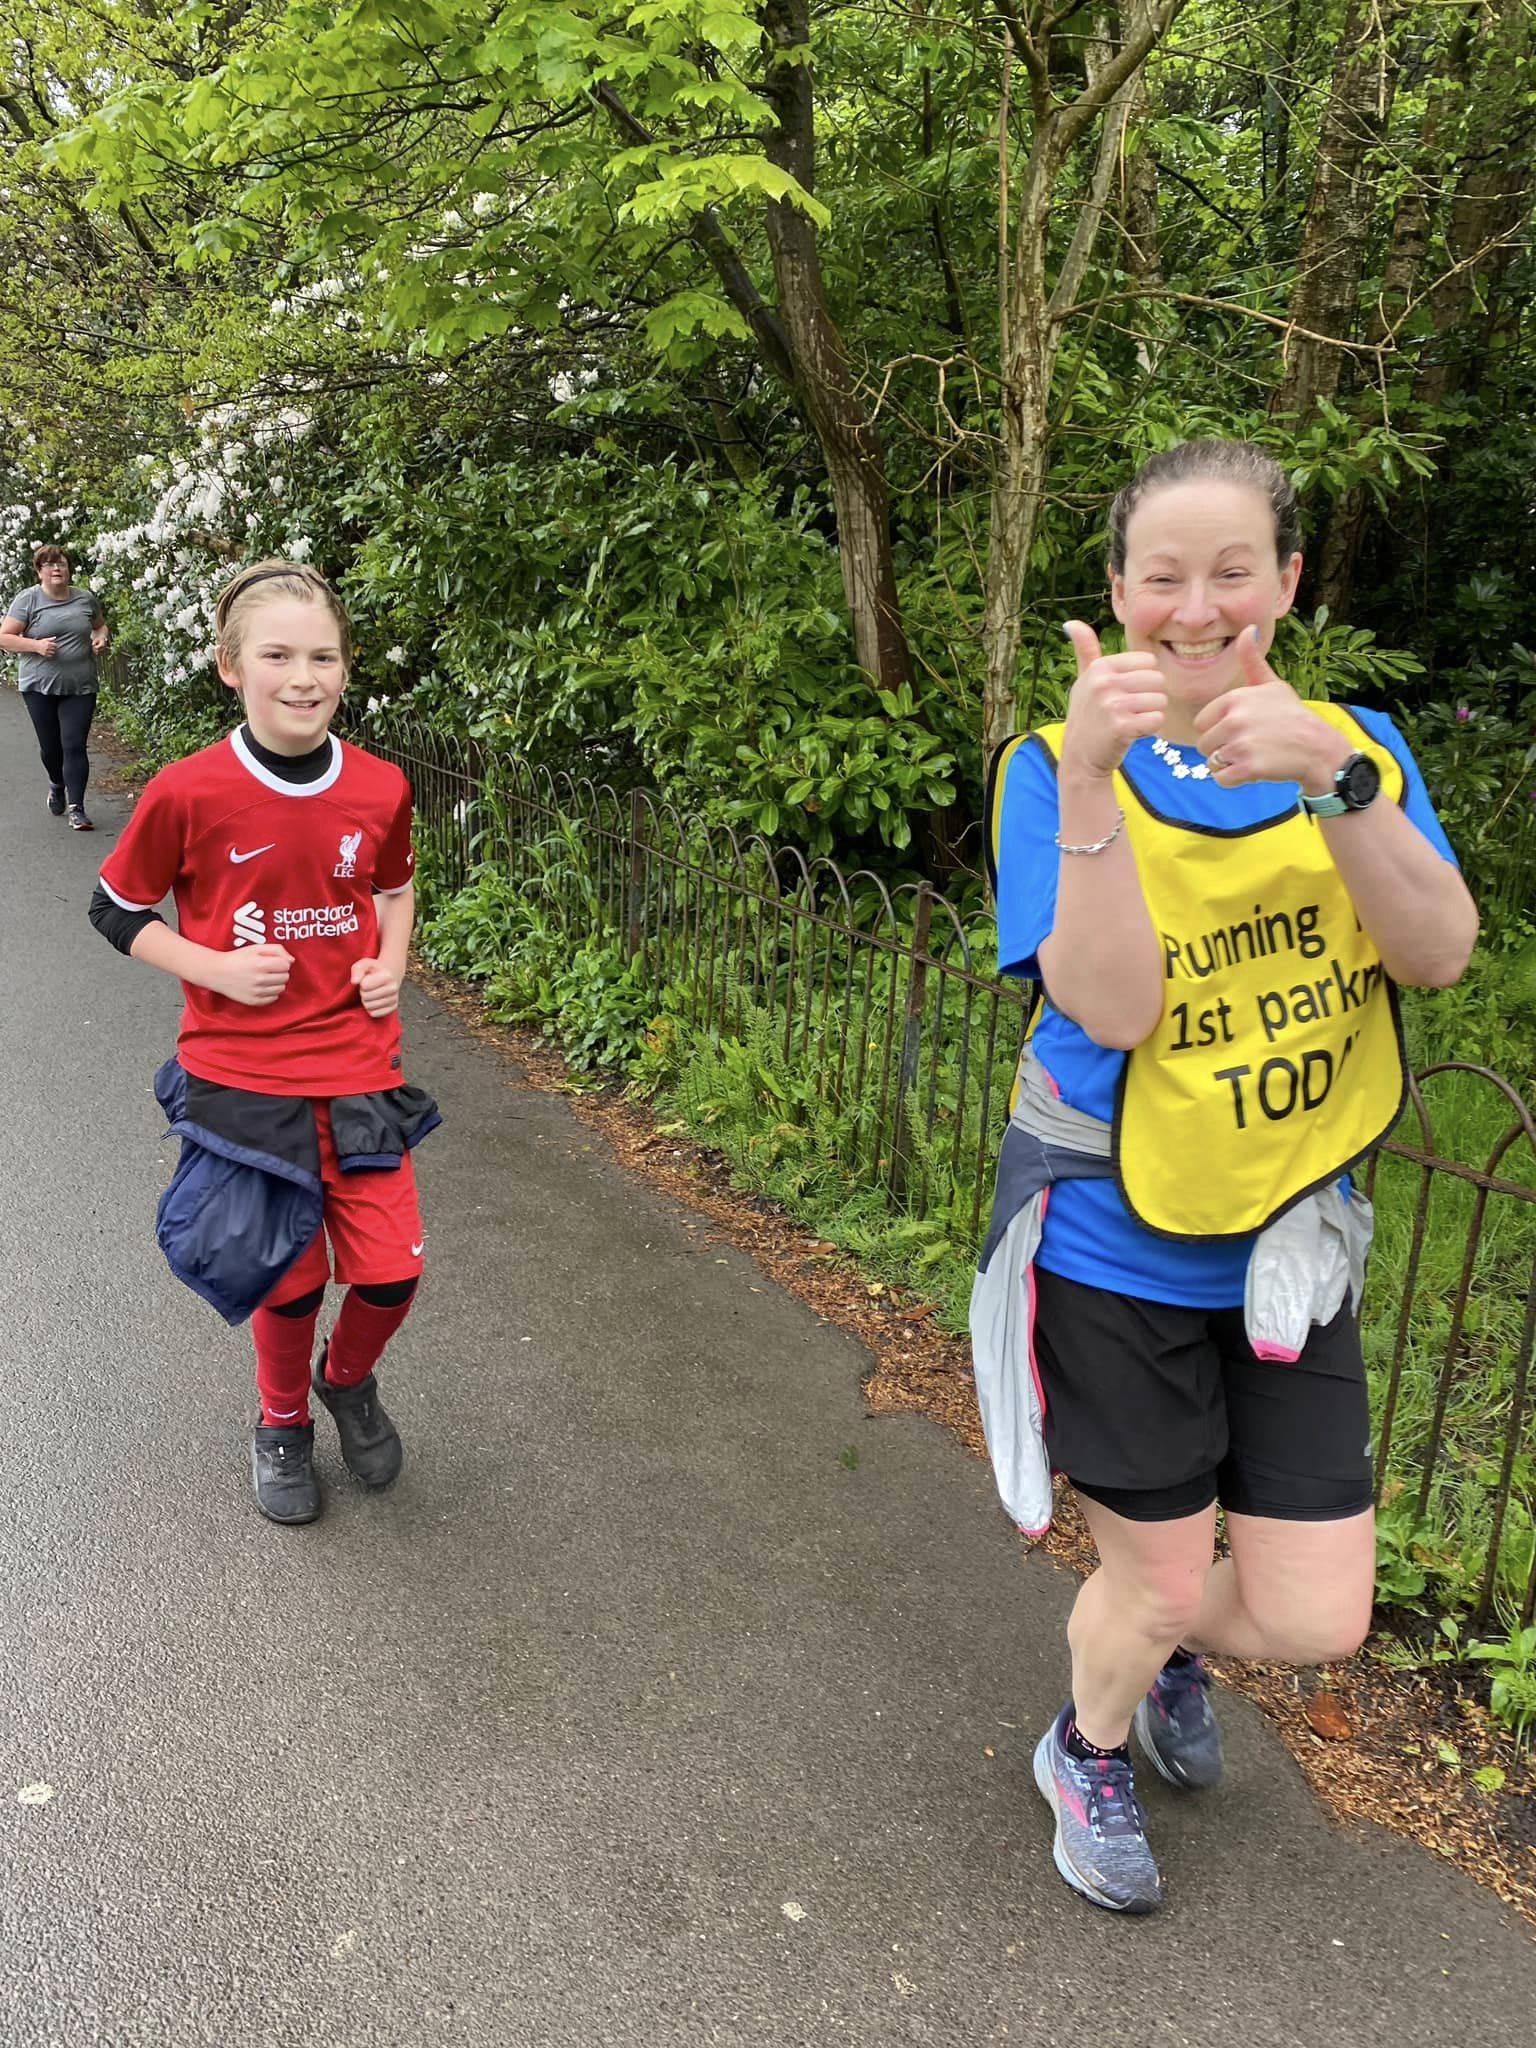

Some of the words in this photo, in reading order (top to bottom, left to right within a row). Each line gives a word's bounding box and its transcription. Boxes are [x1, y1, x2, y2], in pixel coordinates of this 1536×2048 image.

[273, 901, 355, 924] standard
[273, 914, 359, 941] chartered
[1161, 904, 1327, 980] Running
[1169, 997, 1236, 1051] 1st
[1213, 1030, 1361, 1130] TOD
